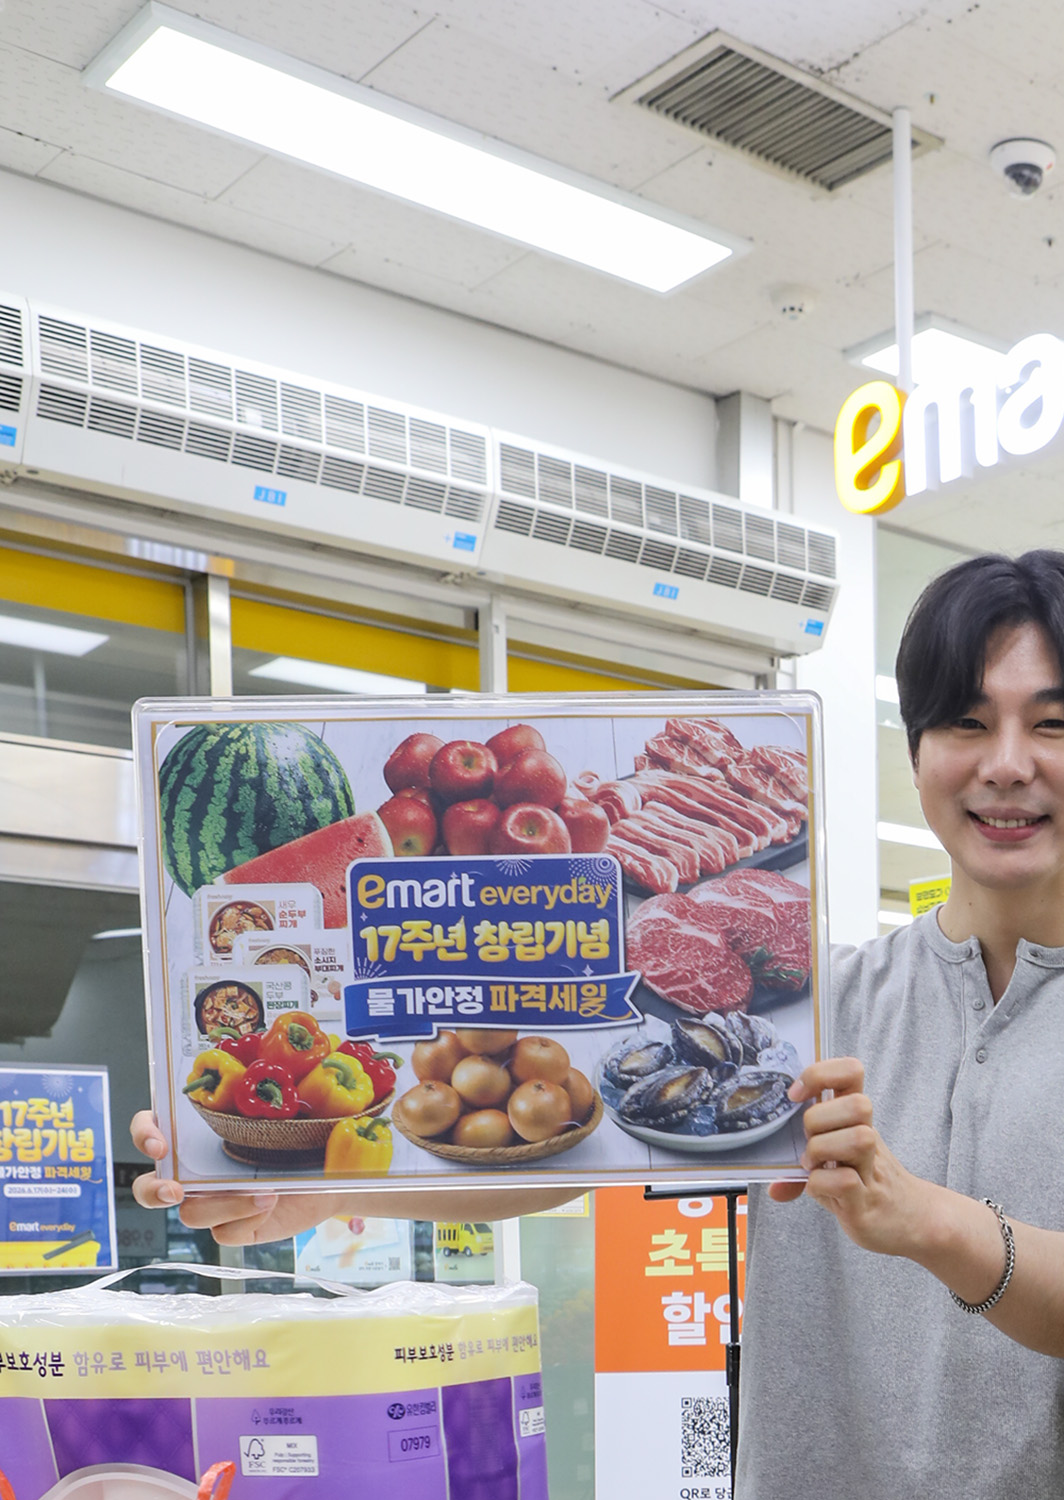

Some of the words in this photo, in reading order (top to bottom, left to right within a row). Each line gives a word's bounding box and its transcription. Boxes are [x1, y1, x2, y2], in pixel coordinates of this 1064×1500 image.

[357, 873, 476, 909] emart
[479, 876, 612, 909] everyday
[359, 915, 468, 962] 17주년
[473, 918, 610, 962] 창립기념
[366, 985, 483, 1017] 물가안정
[489, 983, 632, 1021] 파격세일
[0, 1096, 75, 1129] 17주년
[9, 1219, 40, 1233] emart
[40, 1224, 76, 1233] everyday
[72, 1351, 127, 1377] 함유로
[134, 1350, 189, 1374] 피부에
[196, 1349, 271, 1375] 편안해요
[394, 1342, 455, 1364] 피부보호성분
[400, 1435, 431, 1452] 07979
[680, 1488, 711, 1500] QR로
